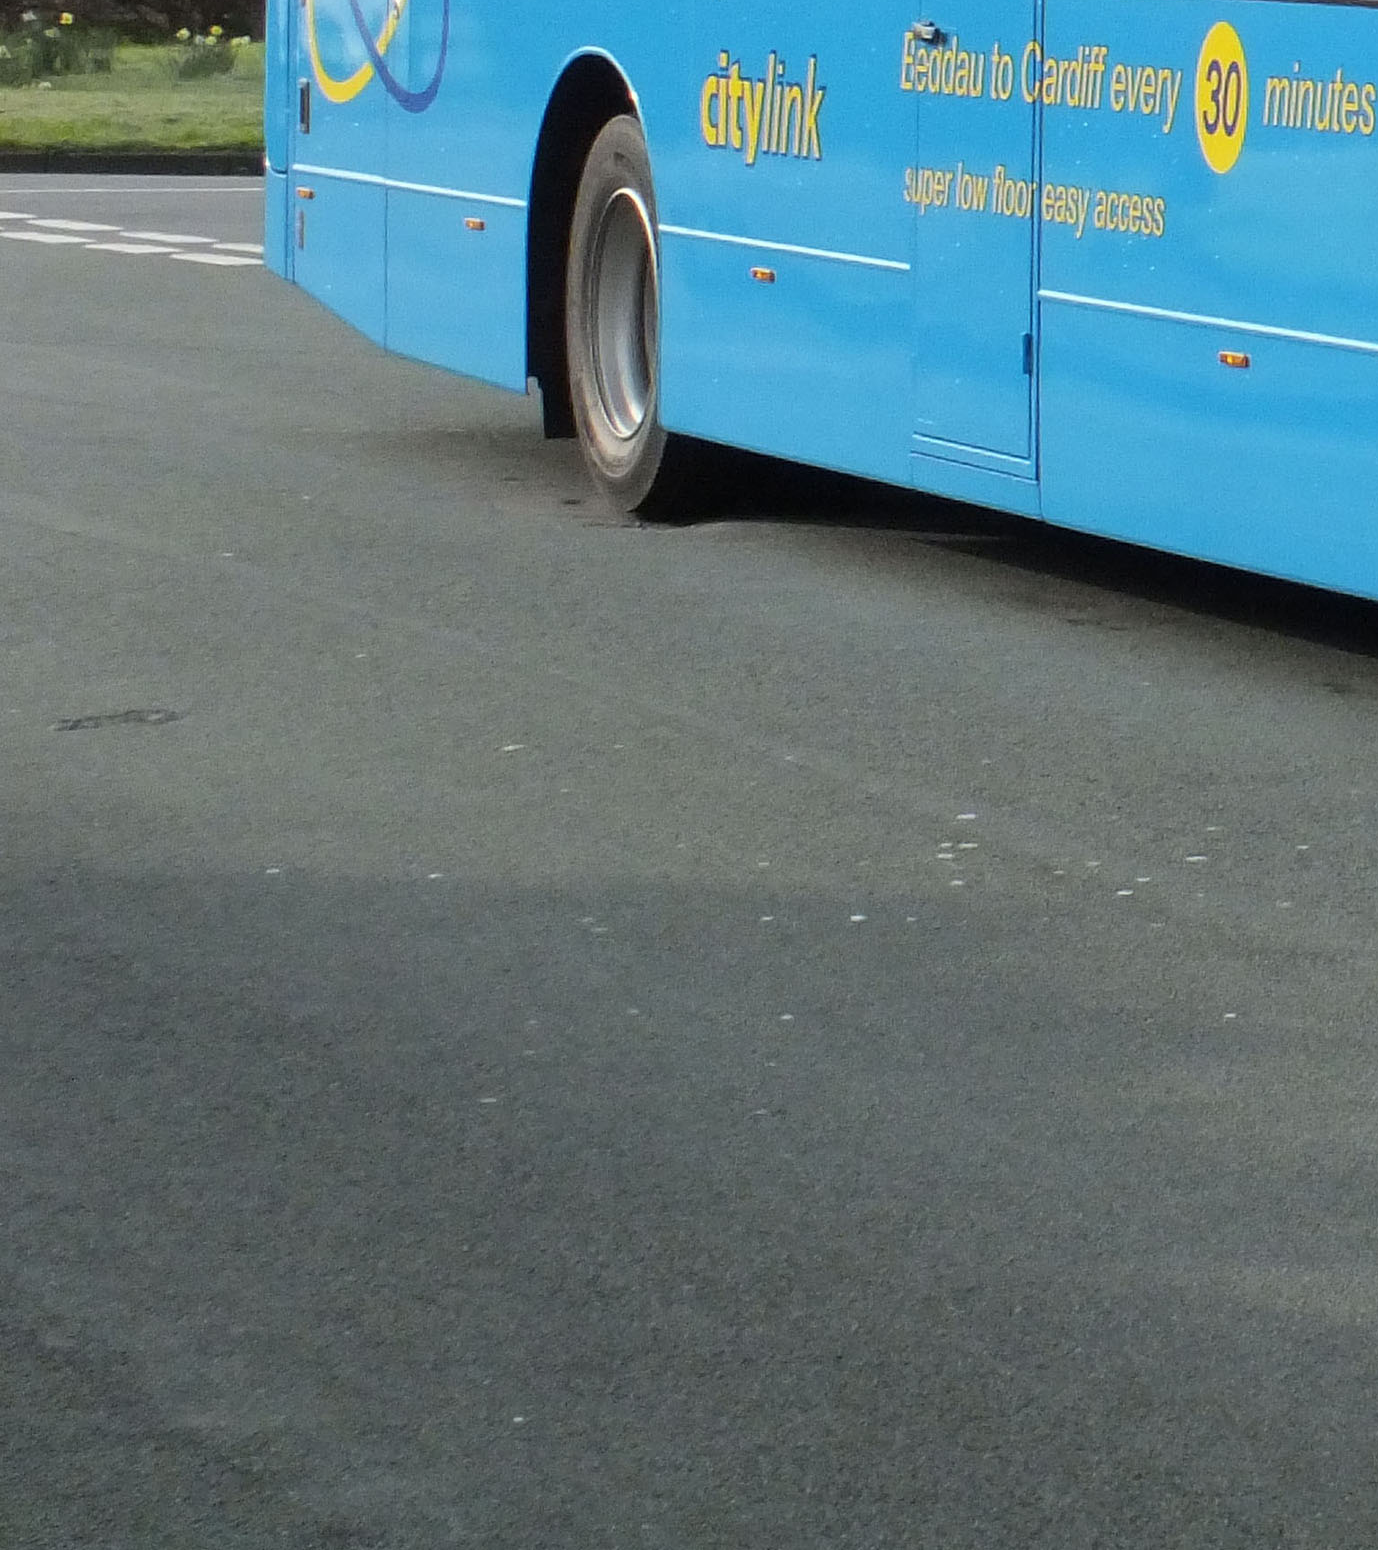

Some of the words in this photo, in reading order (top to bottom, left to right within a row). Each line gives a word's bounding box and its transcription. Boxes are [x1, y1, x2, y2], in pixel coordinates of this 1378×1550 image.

[701, 50, 826, 166] citylink
[990, 41, 1014, 100] to
[1021, 40, 1109, 109] Cardiff
[1110, 62, 1183, 134] every
[1202, 61, 1241, 138] 30
[1262, 61, 1377, 137] minutes
[903, 166, 953, 216] super
[956, 161, 989, 211] low
[993, 164, 1037, 218] floor
[1042, 183, 1091, 240] easy
[1094, 190, 1166, 238] access
